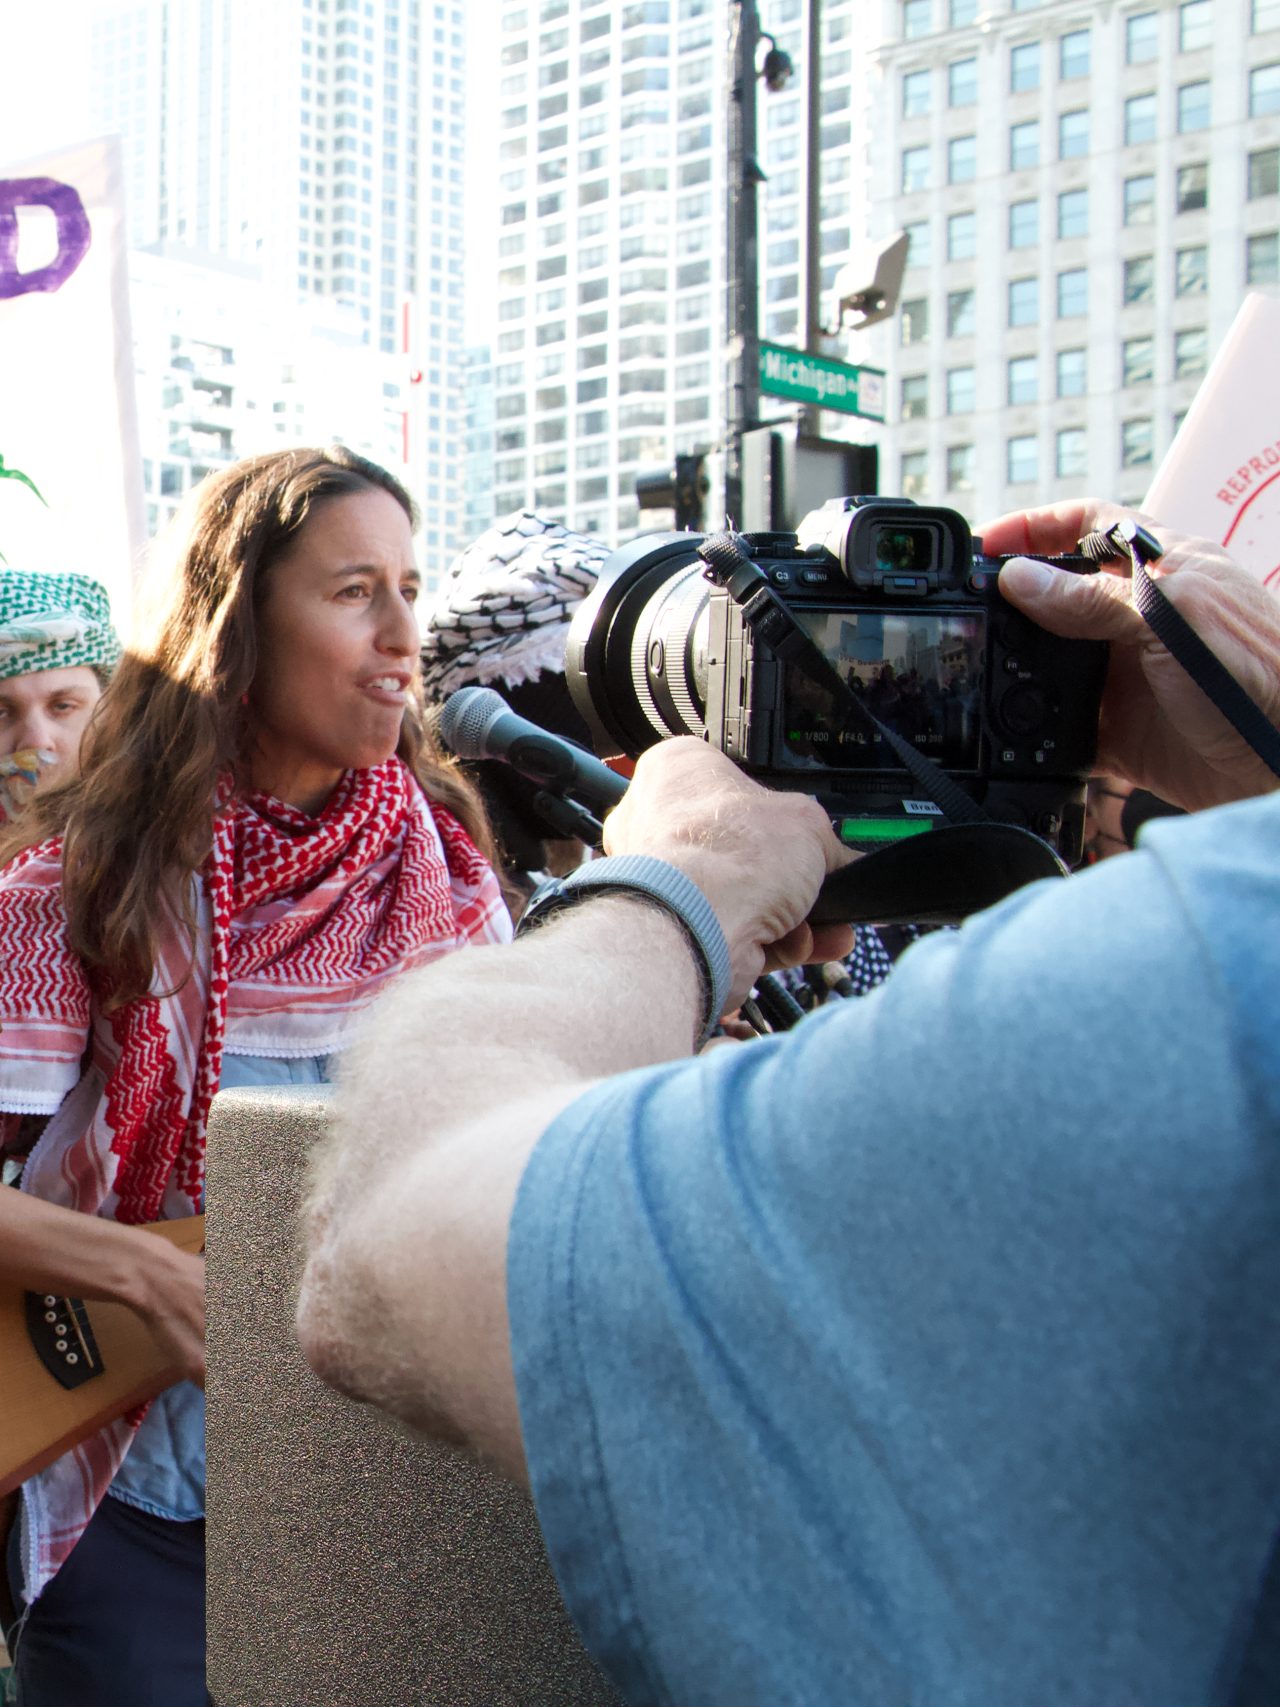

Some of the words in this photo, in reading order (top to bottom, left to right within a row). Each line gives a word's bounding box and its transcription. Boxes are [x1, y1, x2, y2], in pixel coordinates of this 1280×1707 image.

[765, 351, 847, 400] Michigan
[1216, 440, 1280, 506] REPRO
[776, 571, 789, 580] C3
[807, 572, 827, 581] MENU
